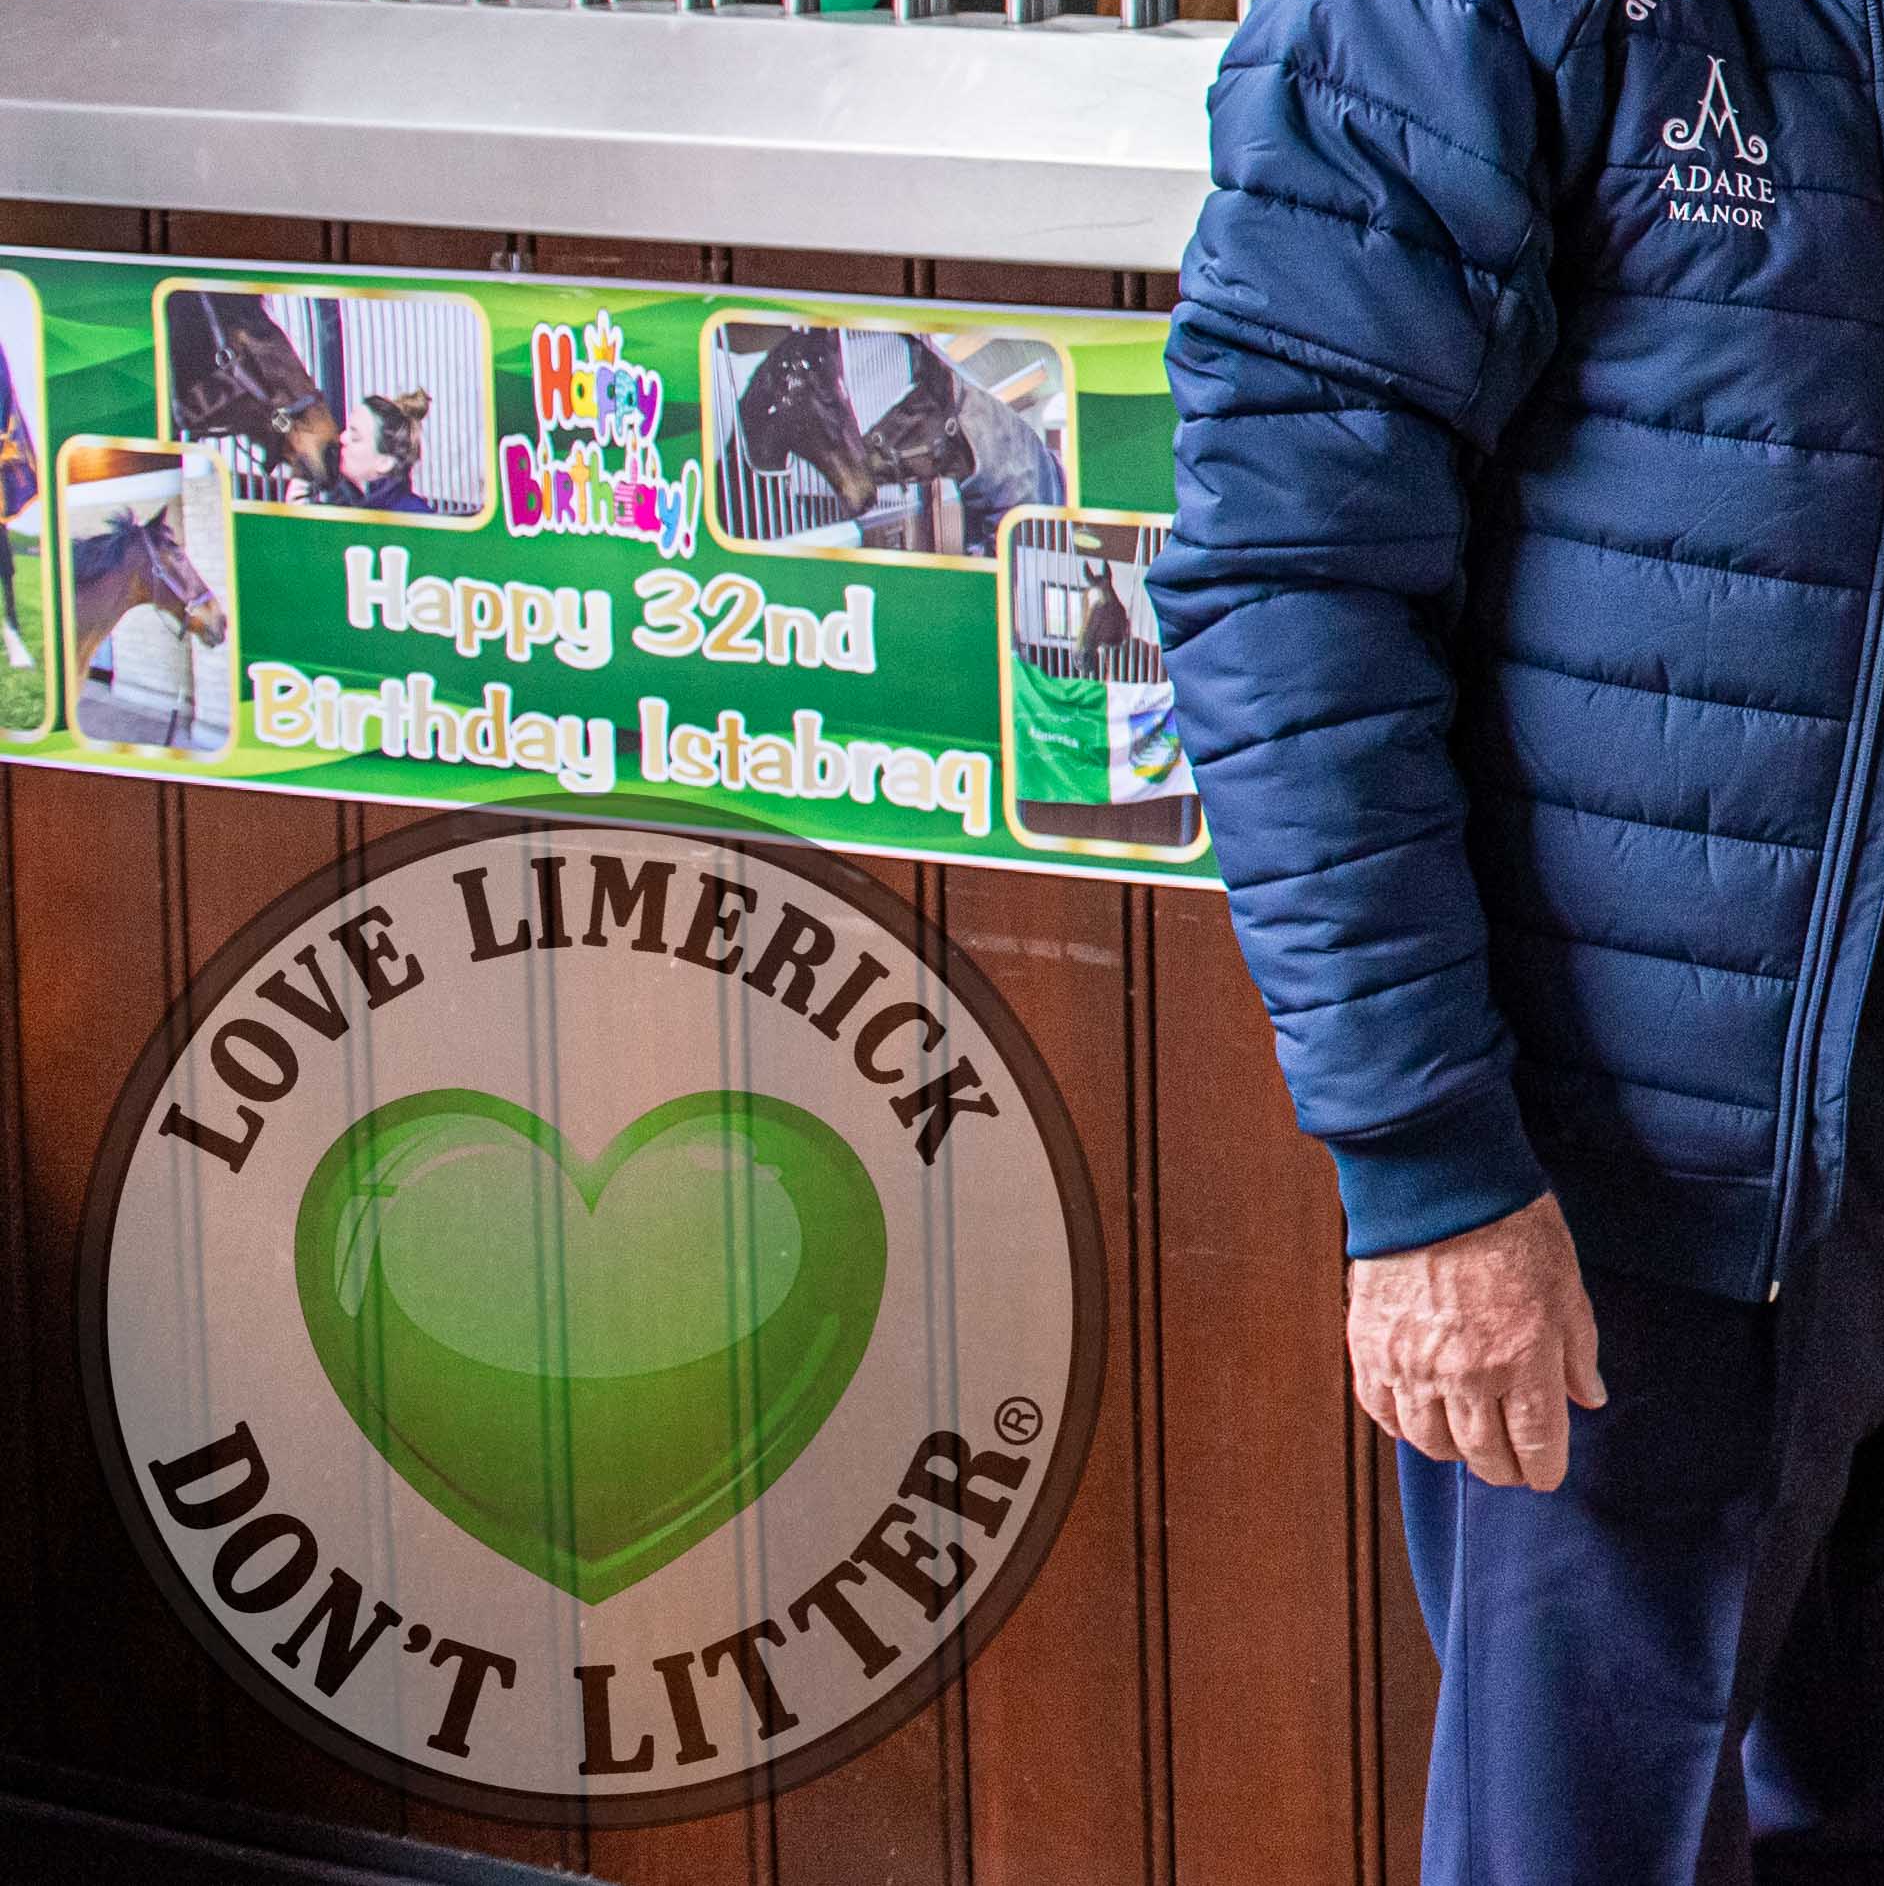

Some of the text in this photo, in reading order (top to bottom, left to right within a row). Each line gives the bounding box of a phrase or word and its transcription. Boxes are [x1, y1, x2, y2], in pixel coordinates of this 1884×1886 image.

[1659, 163, 1776, 204] ADARE
[1668, 200, 1764, 230] MANOR
[536, 330, 659, 438] Happy
[344, 546, 877, 674] Happy 32nd
[249, 662, 990, 836] Birthday Istabraq
